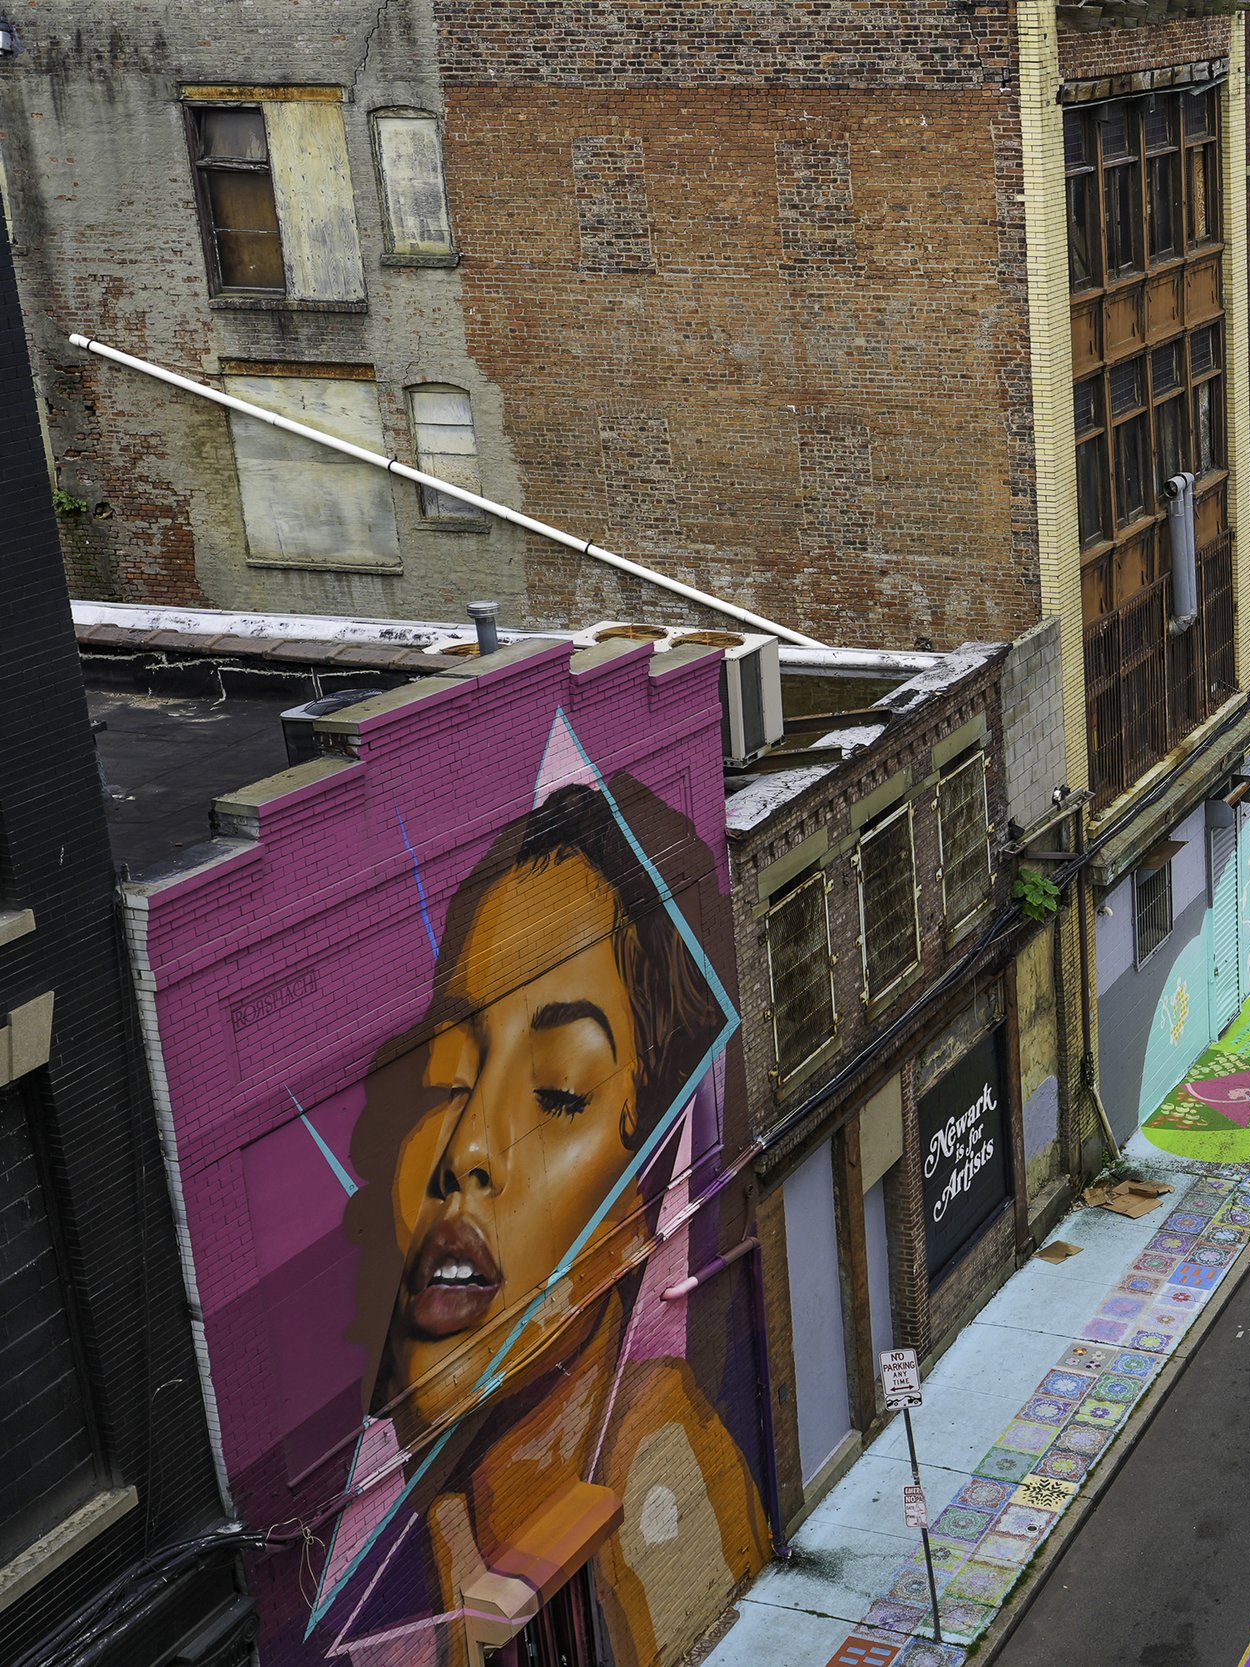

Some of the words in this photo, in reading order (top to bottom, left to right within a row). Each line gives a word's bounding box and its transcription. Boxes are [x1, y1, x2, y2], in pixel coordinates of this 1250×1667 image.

[924, 1082, 997, 1178] Newark
[955, 1142, 965, 1164] is
[965, 1123, 984, 1159] for
[933, 1138, 994, 1222] Artists
[883, 1360, 915, 1372] PARKING
[891, 1352, 905, 1361] NO
[893, 1378, 910, 1386] TIME
